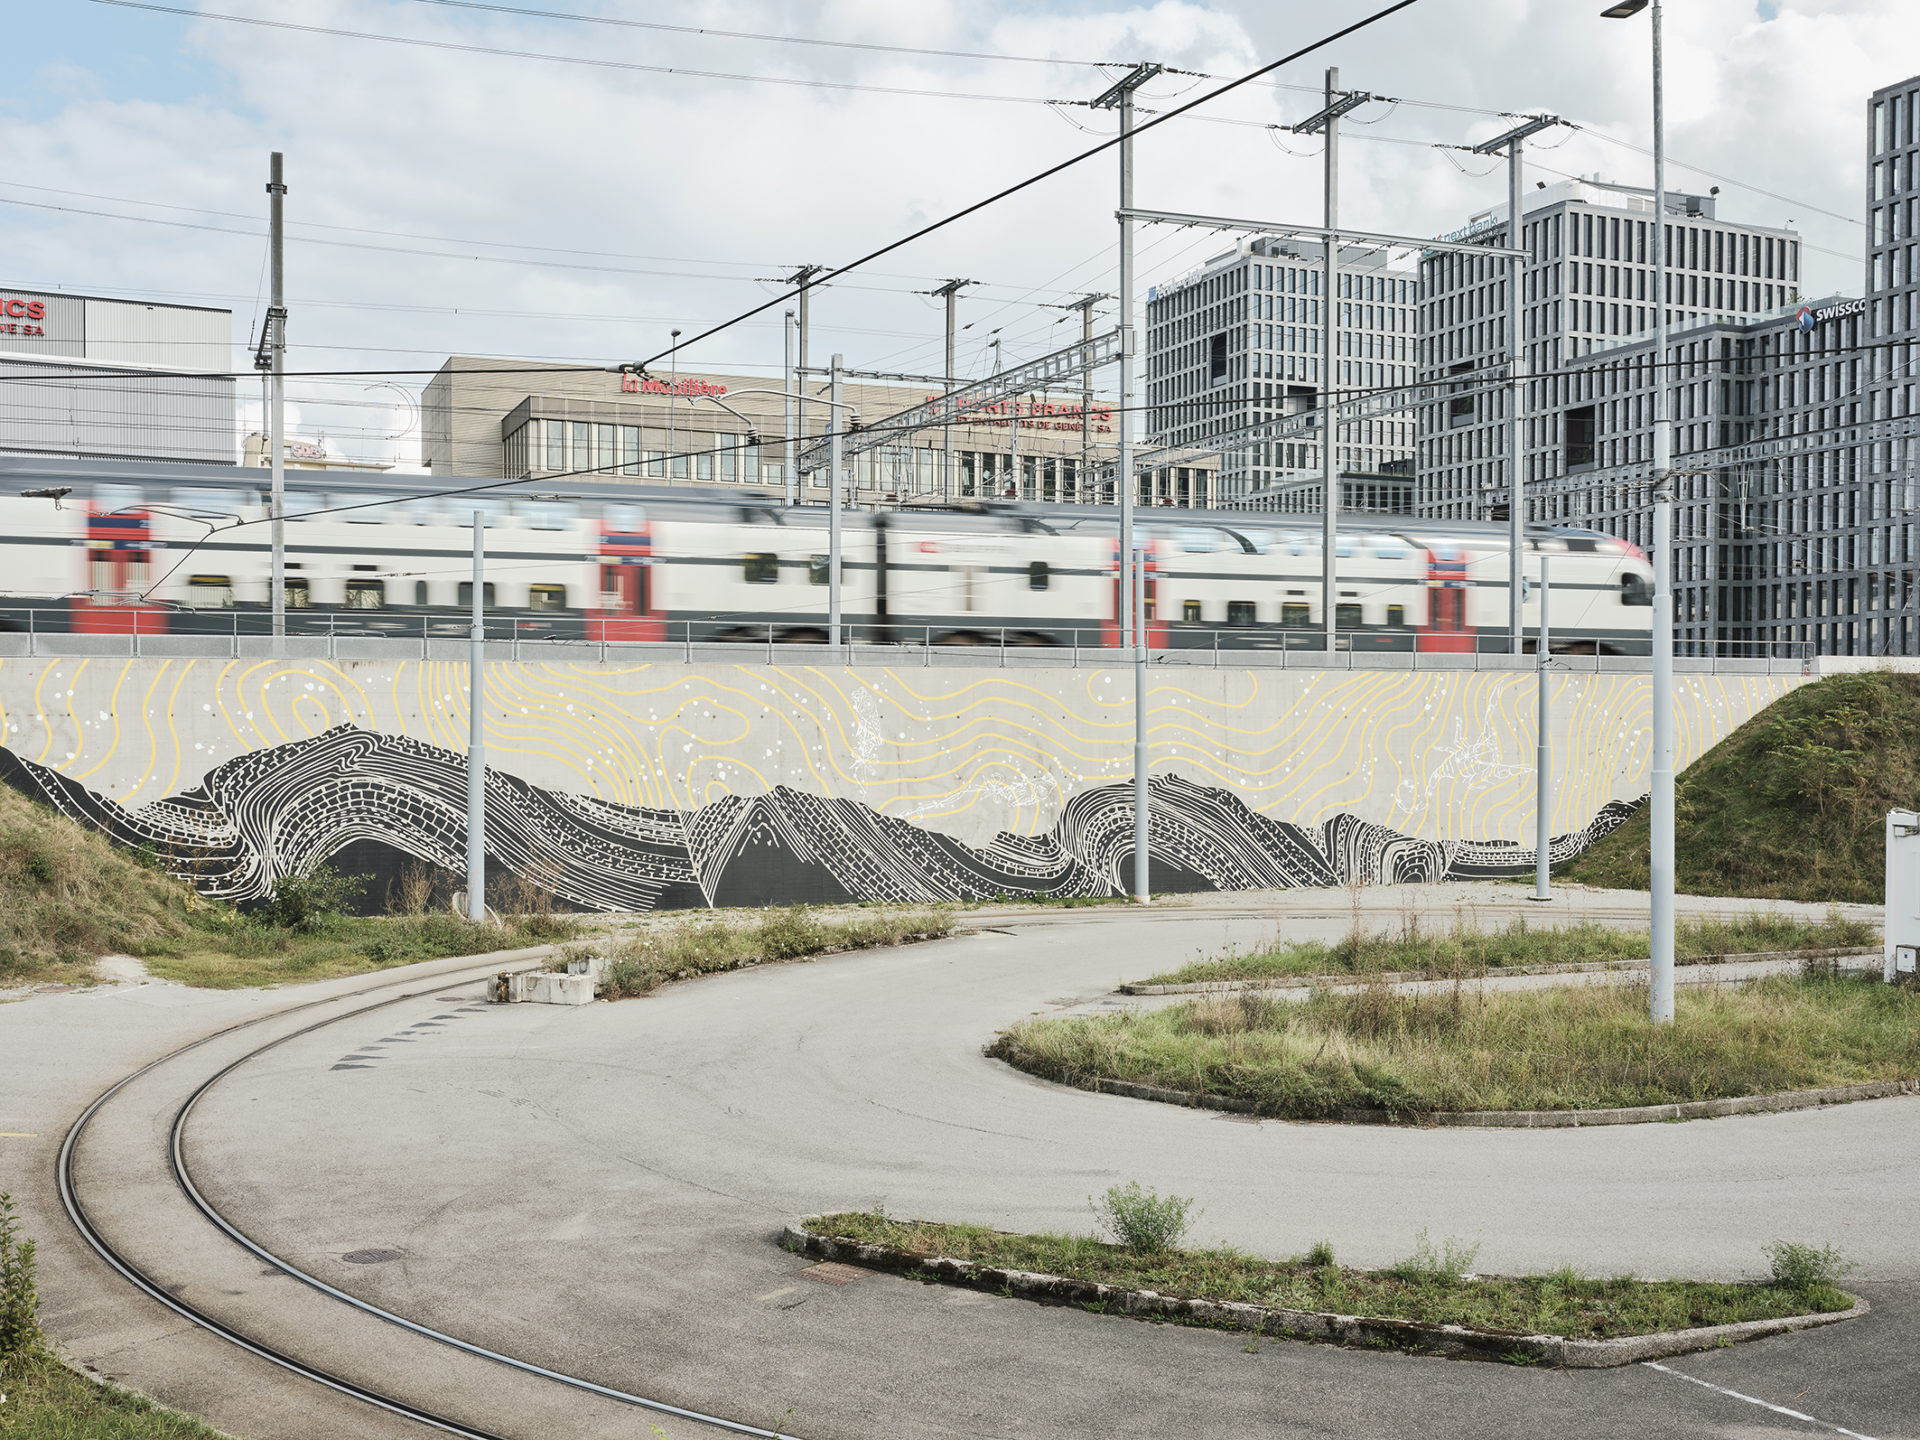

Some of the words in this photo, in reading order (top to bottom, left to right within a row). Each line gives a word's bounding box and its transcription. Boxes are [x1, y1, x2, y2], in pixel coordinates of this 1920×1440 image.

[1444, 226, 1467, 241] next
[1469, 214, 1498, 235] bank
[0, 298, 45, 319] CS
[23, 324, 45, 336] SA
[622, 373, 638, 392] la
[642, 377, 728, 396] Mobilière
[958, 397, 1024, 416] PRTS
[1038, 420, 1052, 430] DE
[1097, 424, 1112, 433] SA
